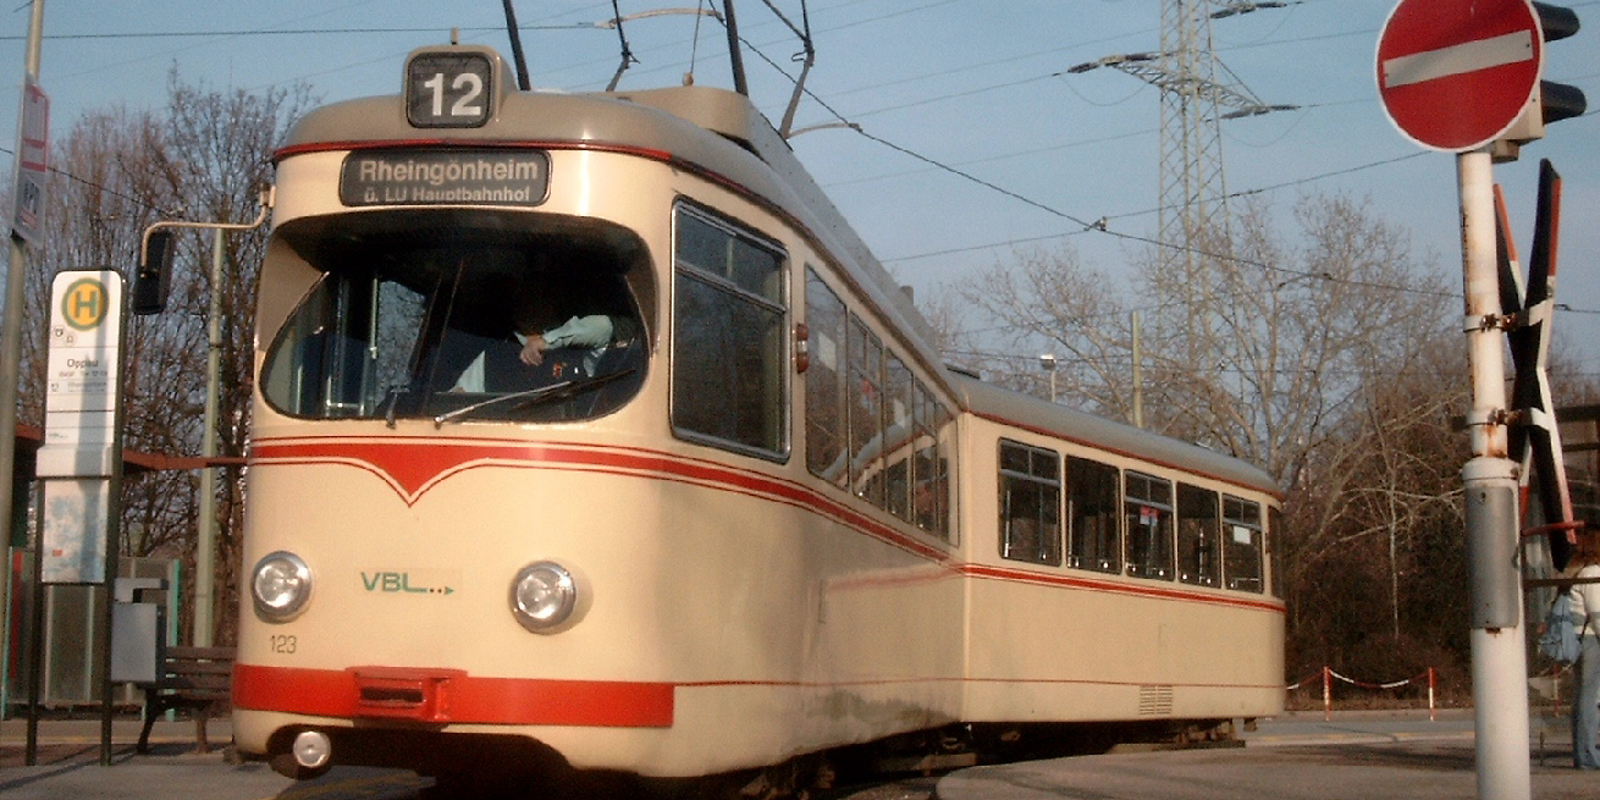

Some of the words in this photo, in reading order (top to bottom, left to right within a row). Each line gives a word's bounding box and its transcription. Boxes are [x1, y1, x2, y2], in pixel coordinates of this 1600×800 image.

[424, 72, 483, 117] 12
[360, 159, 538, 185] Rheingönheim
[385, 187, 408, 202] LU
[412, 186, 530, 201] Hauptbahnhof
[74, 290, 98, 318] H
[270, 635, 297, 654] 123
